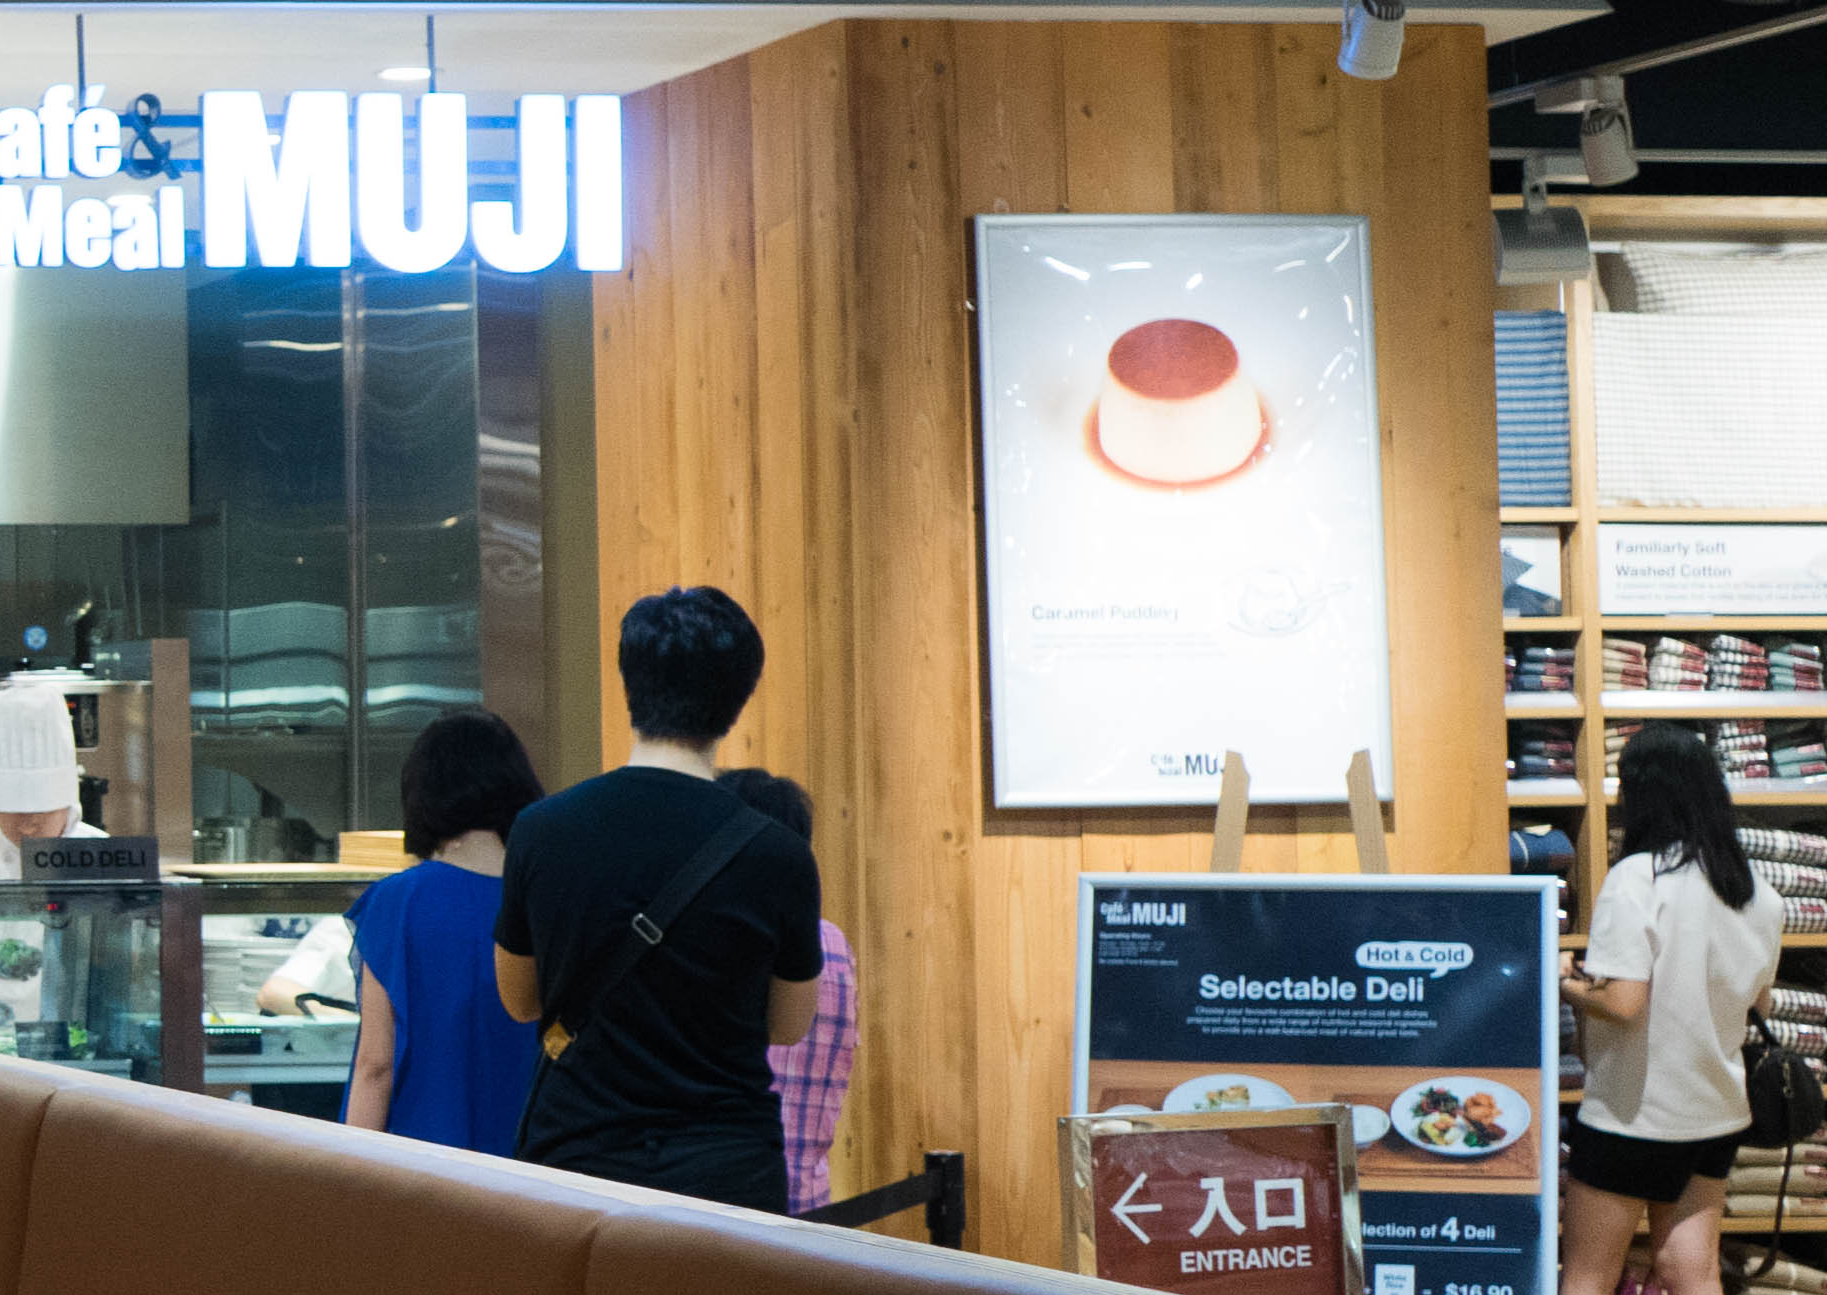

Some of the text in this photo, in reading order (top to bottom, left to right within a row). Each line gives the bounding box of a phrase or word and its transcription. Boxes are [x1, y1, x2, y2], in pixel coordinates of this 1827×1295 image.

[127, 93, 180, 180] &
[201, 90, 624, 273] MUJI
[1615, 540, 1727, 556] Familiarly Soft
[1615, 564, 1732, 578] Washed Cotton
[1031, 604, 1105, 621] Caramel
[34, 850, 146, 868] COLD DELI
[1132, 902, 1186, 926] MUJI
[1367, 947, 1464, 963] Hot & Cold
[1199, 974, 1424, 1003] Selectable Deli
[1188, 1176, 1307, 1238] 入口
[1363, 1216, 1496, 1242] lection of 4 Deli
[1180, 1244, 1313, 1273] ENTRANCE
